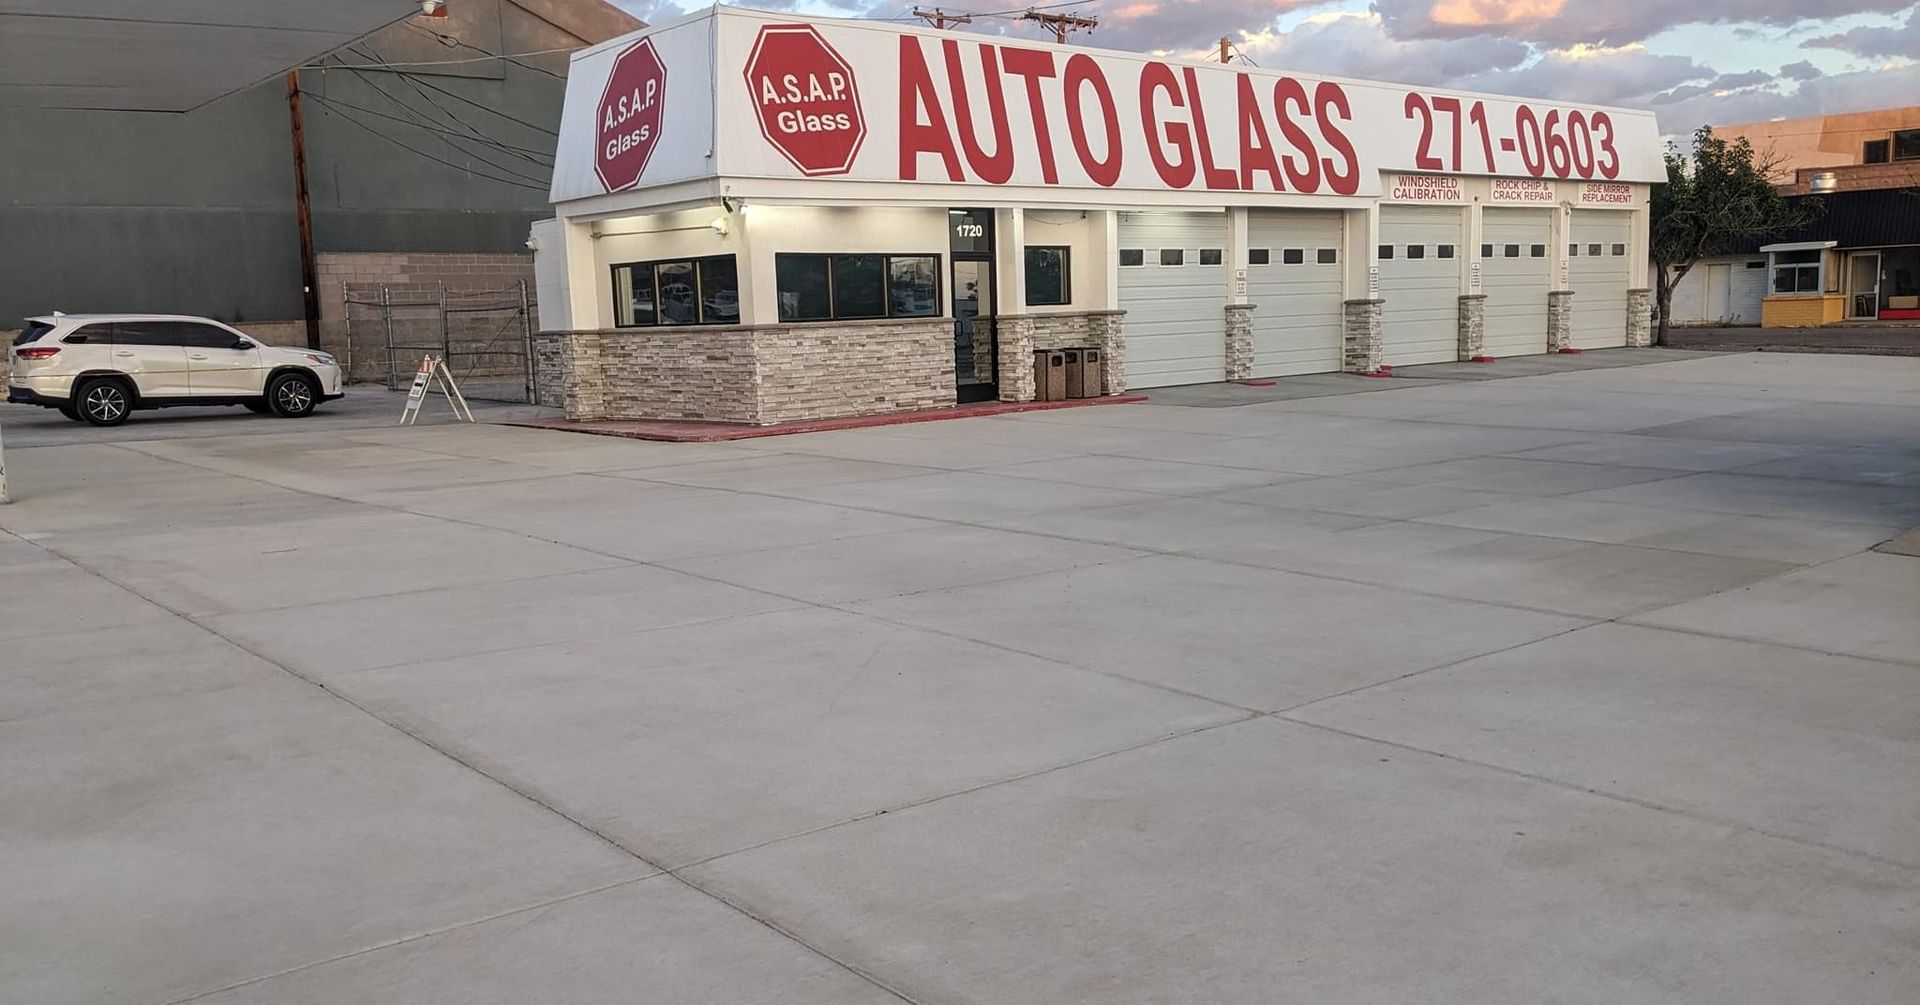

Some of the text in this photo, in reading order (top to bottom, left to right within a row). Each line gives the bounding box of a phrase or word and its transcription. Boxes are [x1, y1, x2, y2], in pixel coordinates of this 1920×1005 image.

[762, 72, 847, 105] A.S.A.P.
[899, 35, 1360, 196] AUTO GLASS
[777, 110, 850, 134] Glass
[1405, 92, 1620, 180] 271-0603
[606, 124, 649, 161] Glass
[1398, 176, 1458, 188] WINDSHIELD
[1495, 180, 1549, 191] ROCK CHIP &
[1393, 188, 1460, 200] CALIBRATION
[1586, 184, 1630, 194] SIDE MIRROR
[1493, 191, 1553, 200] CRACK REPAIR
[1582, 194, 1632, 203] REPLACEMENT
[956, 225, 983, 237] 1720
